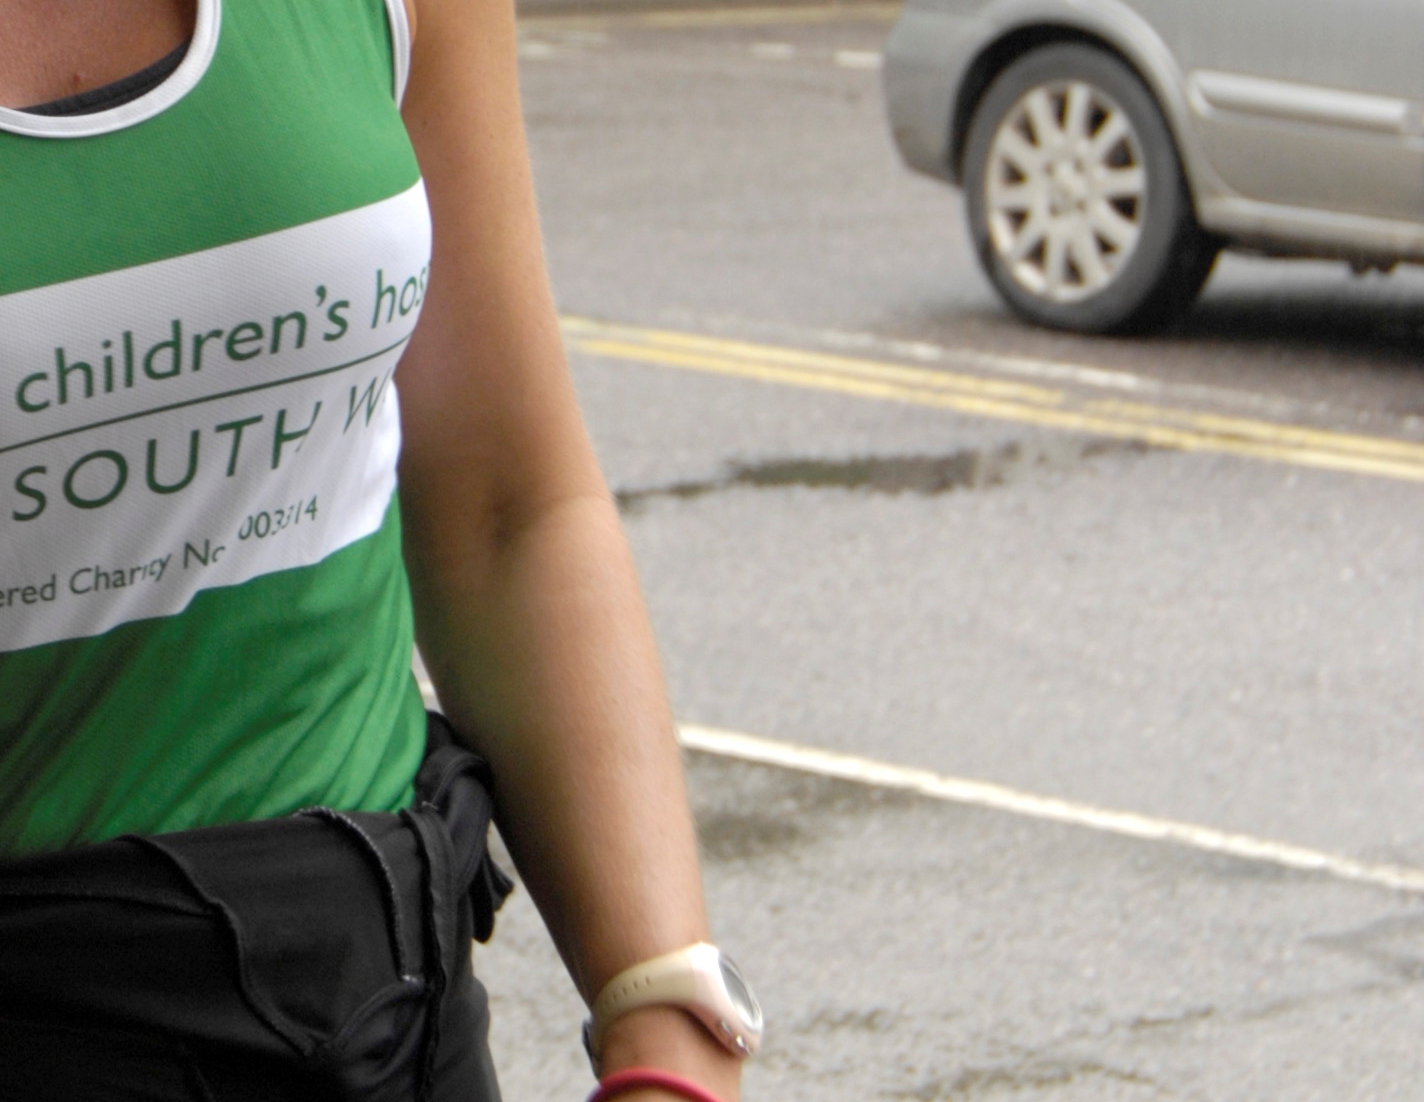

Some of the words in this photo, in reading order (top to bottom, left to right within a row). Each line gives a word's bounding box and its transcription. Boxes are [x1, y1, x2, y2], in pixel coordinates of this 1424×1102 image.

[15, 284, 350, 414] children's
[11, 400, 323, 522] SOUTH
[69, 553, 173, 595] Charity
